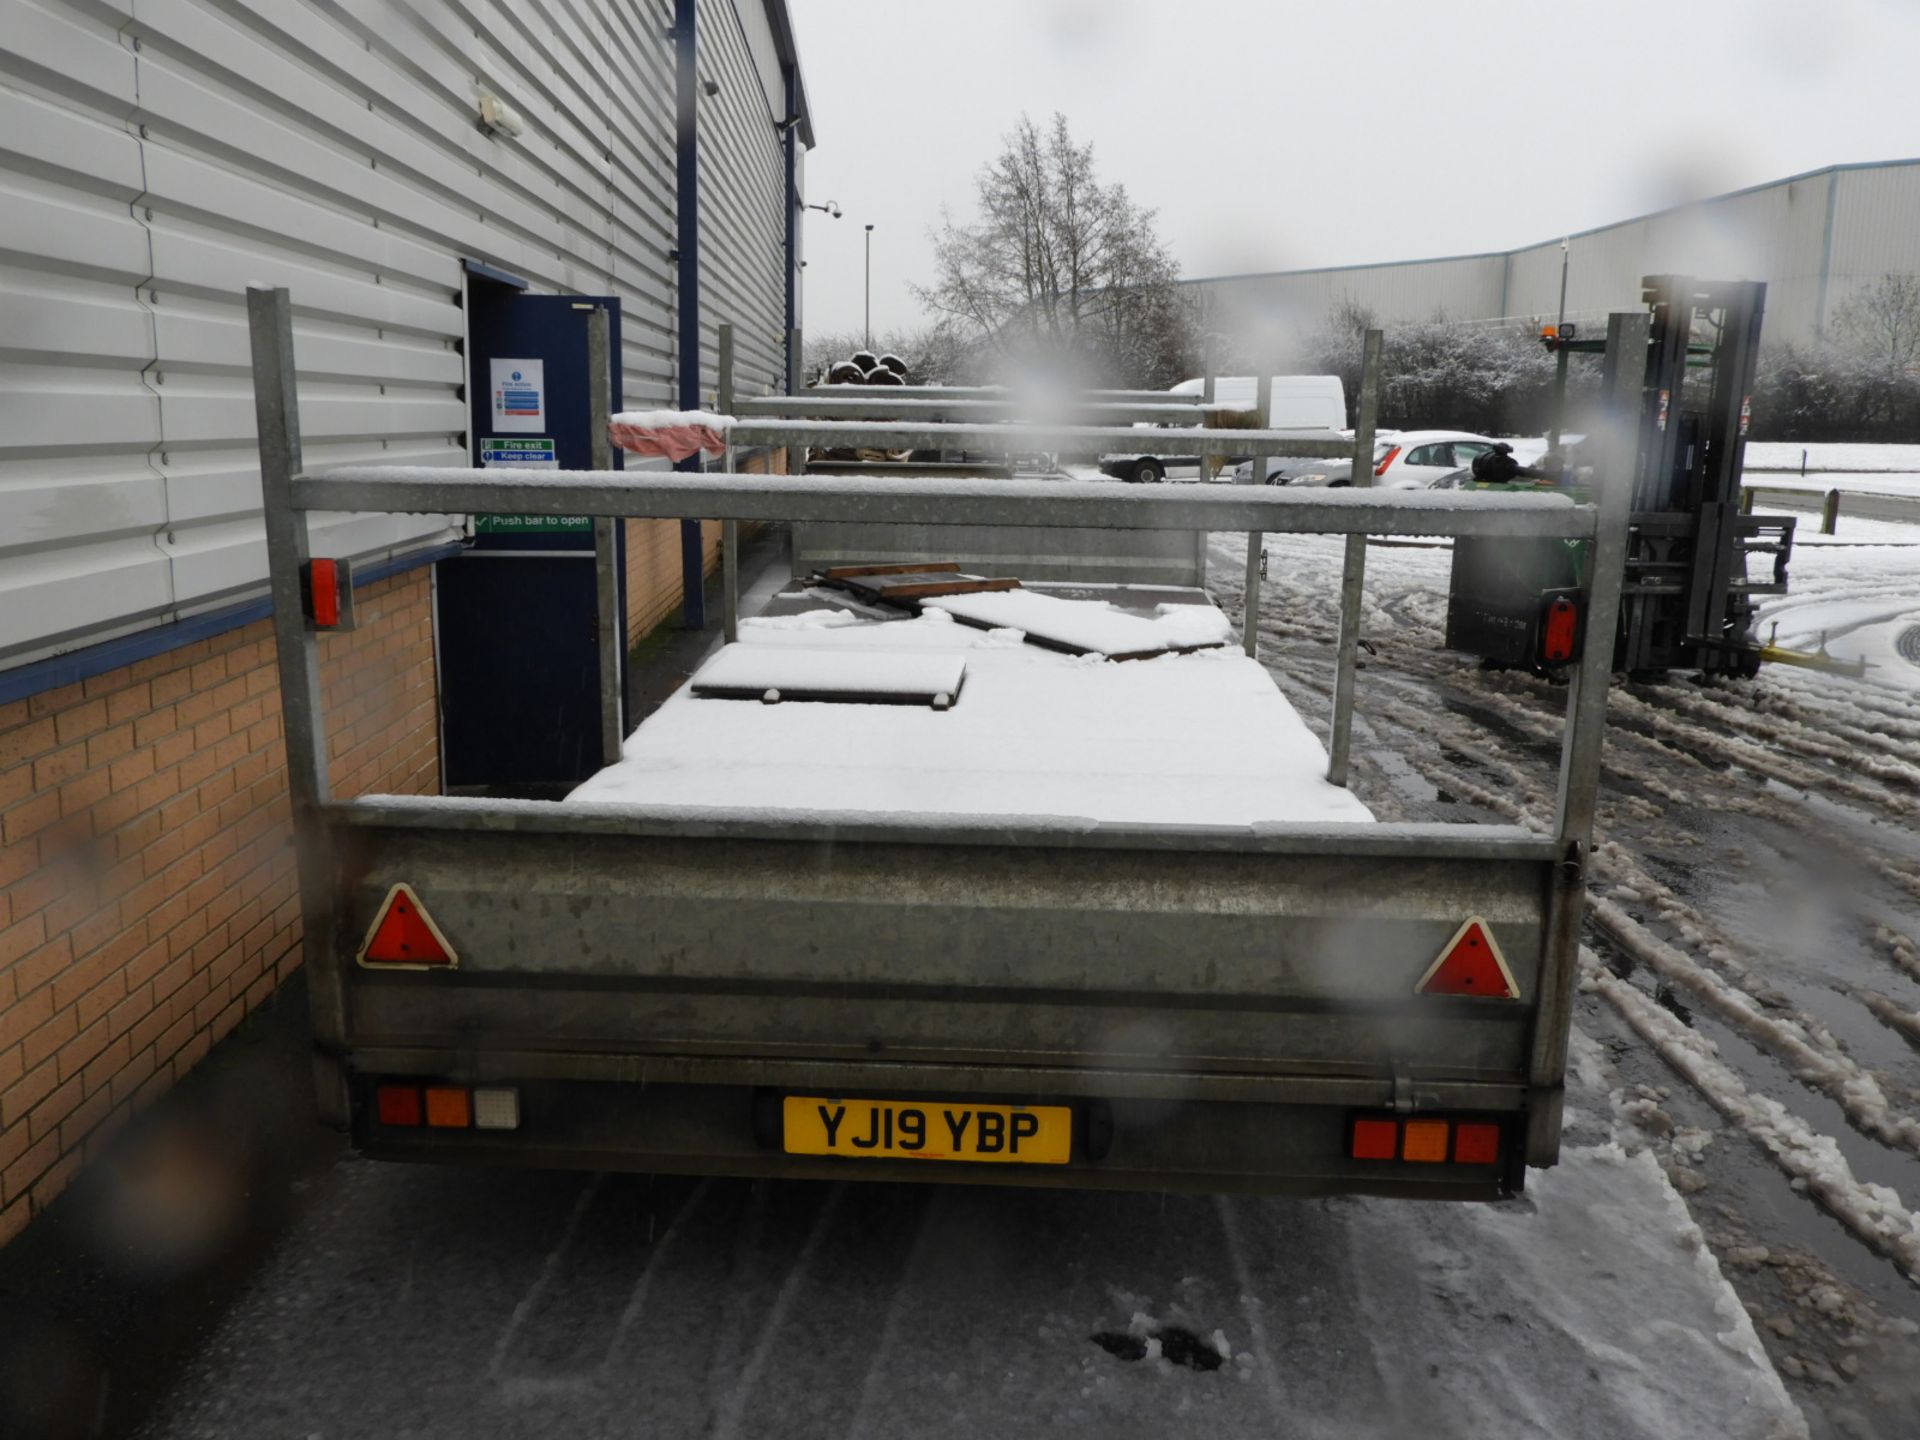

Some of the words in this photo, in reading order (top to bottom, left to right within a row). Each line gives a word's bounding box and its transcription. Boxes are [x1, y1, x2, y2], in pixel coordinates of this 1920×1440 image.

[504, 441, 521, 449] Fire
[524, 441, 543, 449] exit
[501, 452, 523, 460] Keep
[493, 516, 522, 525] Push
[525, 516, 544, 525] bar
[546, 517, 558, 525] to
[560, 517, 589, 526] open
[818, 1105, 926, 1150] YJ19
[944, 1110, 1039, 1153] YBP
